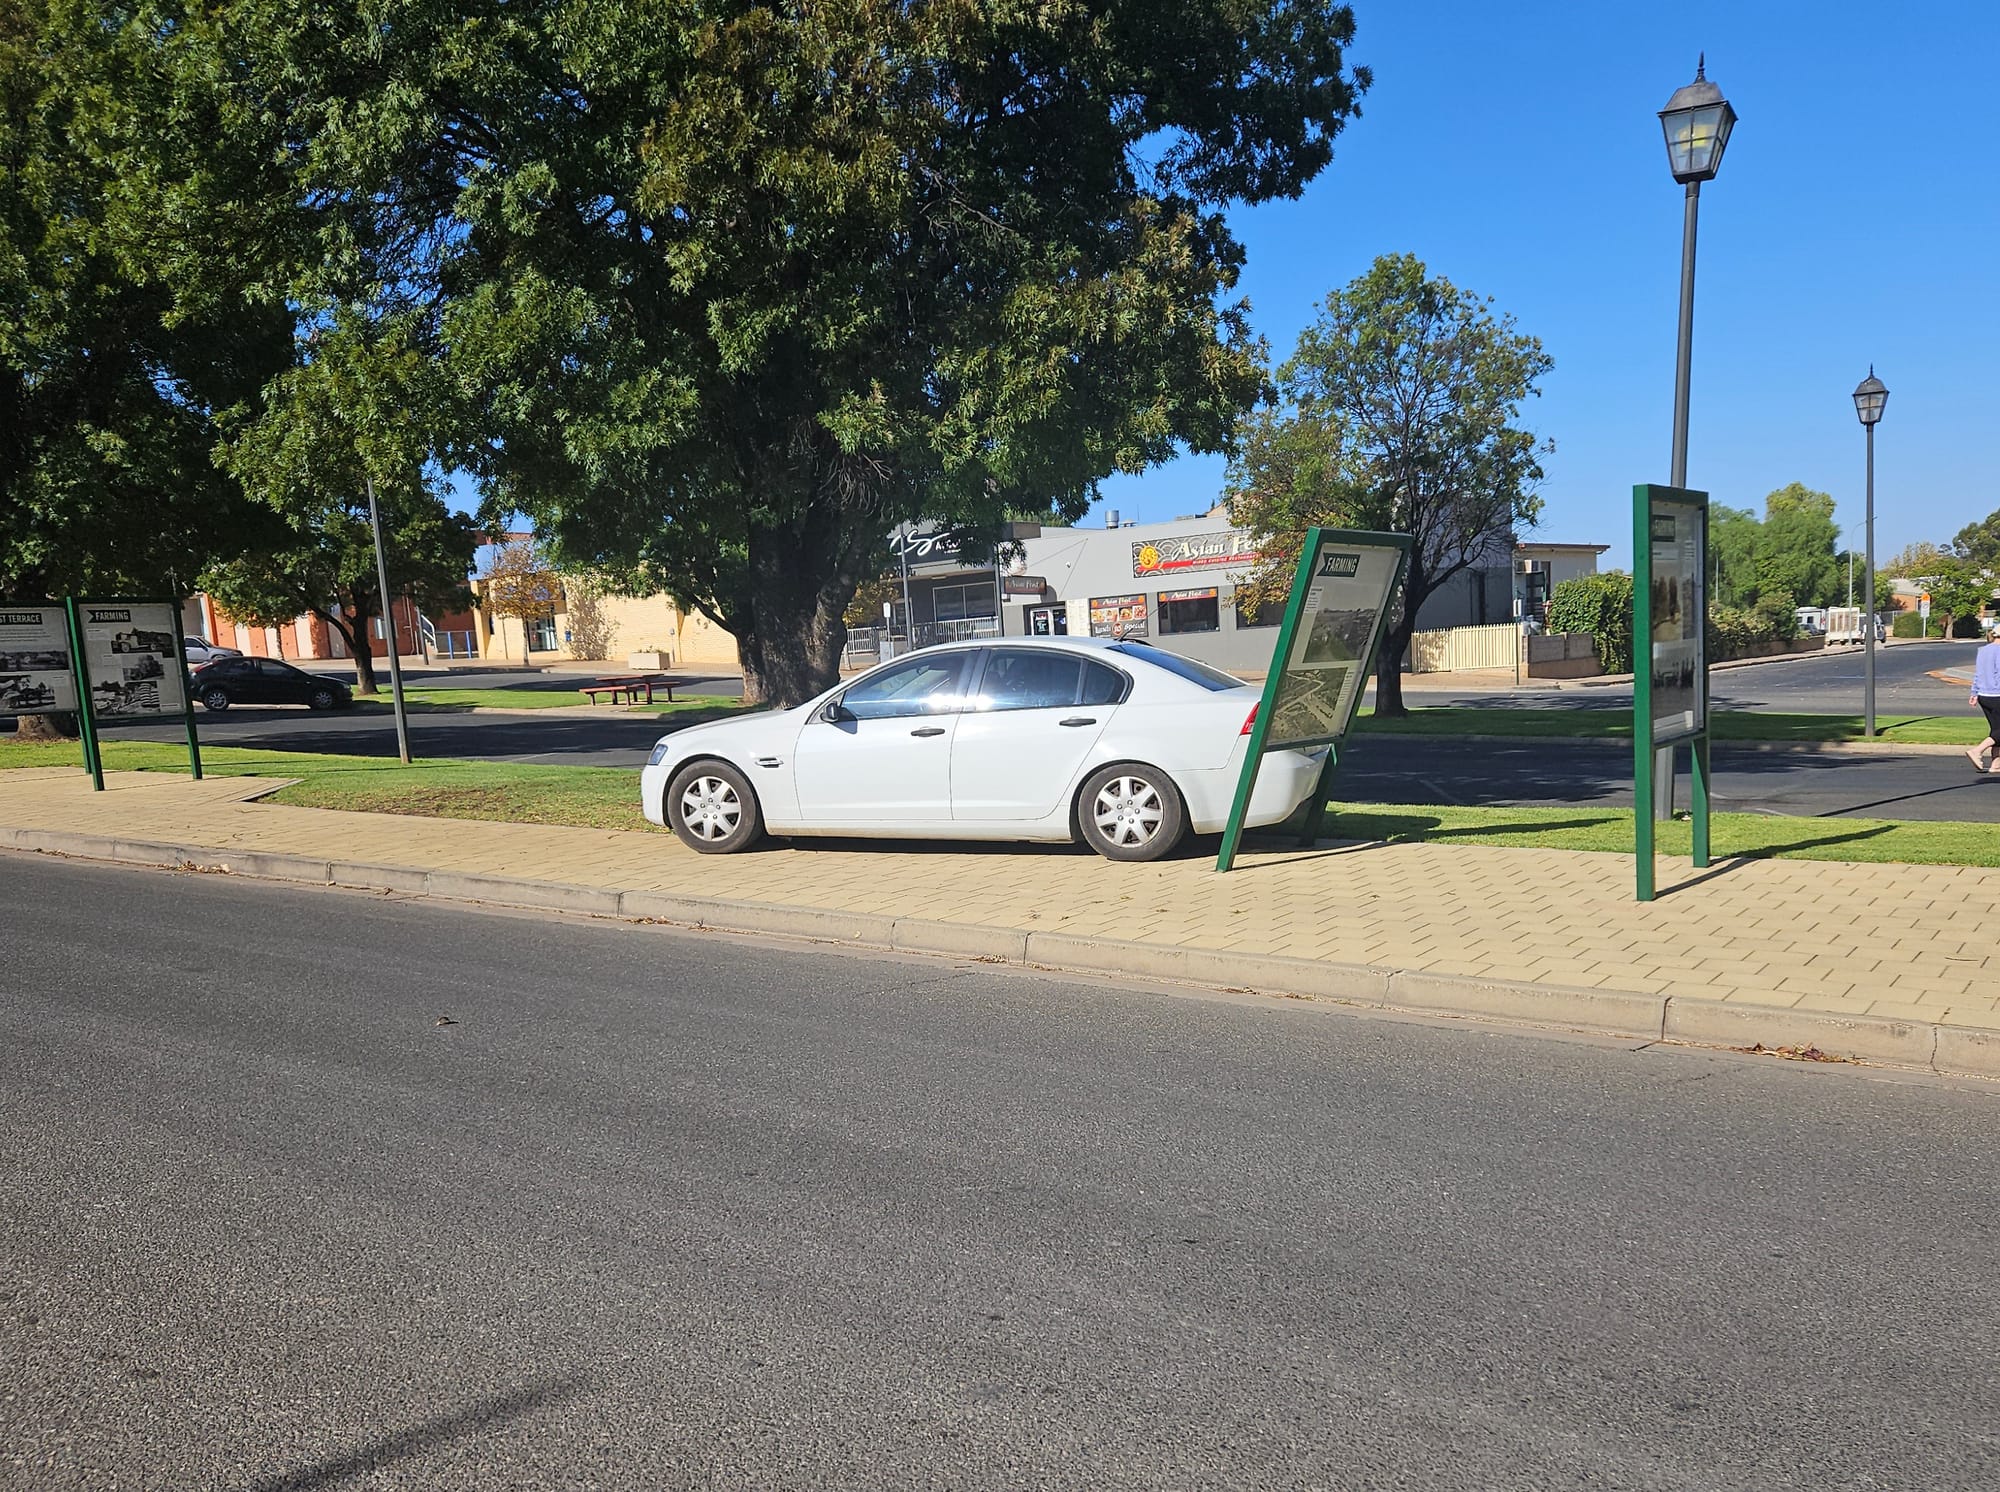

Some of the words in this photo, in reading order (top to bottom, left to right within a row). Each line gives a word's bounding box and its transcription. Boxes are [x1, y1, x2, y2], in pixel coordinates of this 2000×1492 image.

[1171, 539, 1227, 560] Asian
[1325, 557, 1358, 573] FARMING
[8, 614, 41, 624] TERRACE
[95, 611, 129, 621] FARMING
